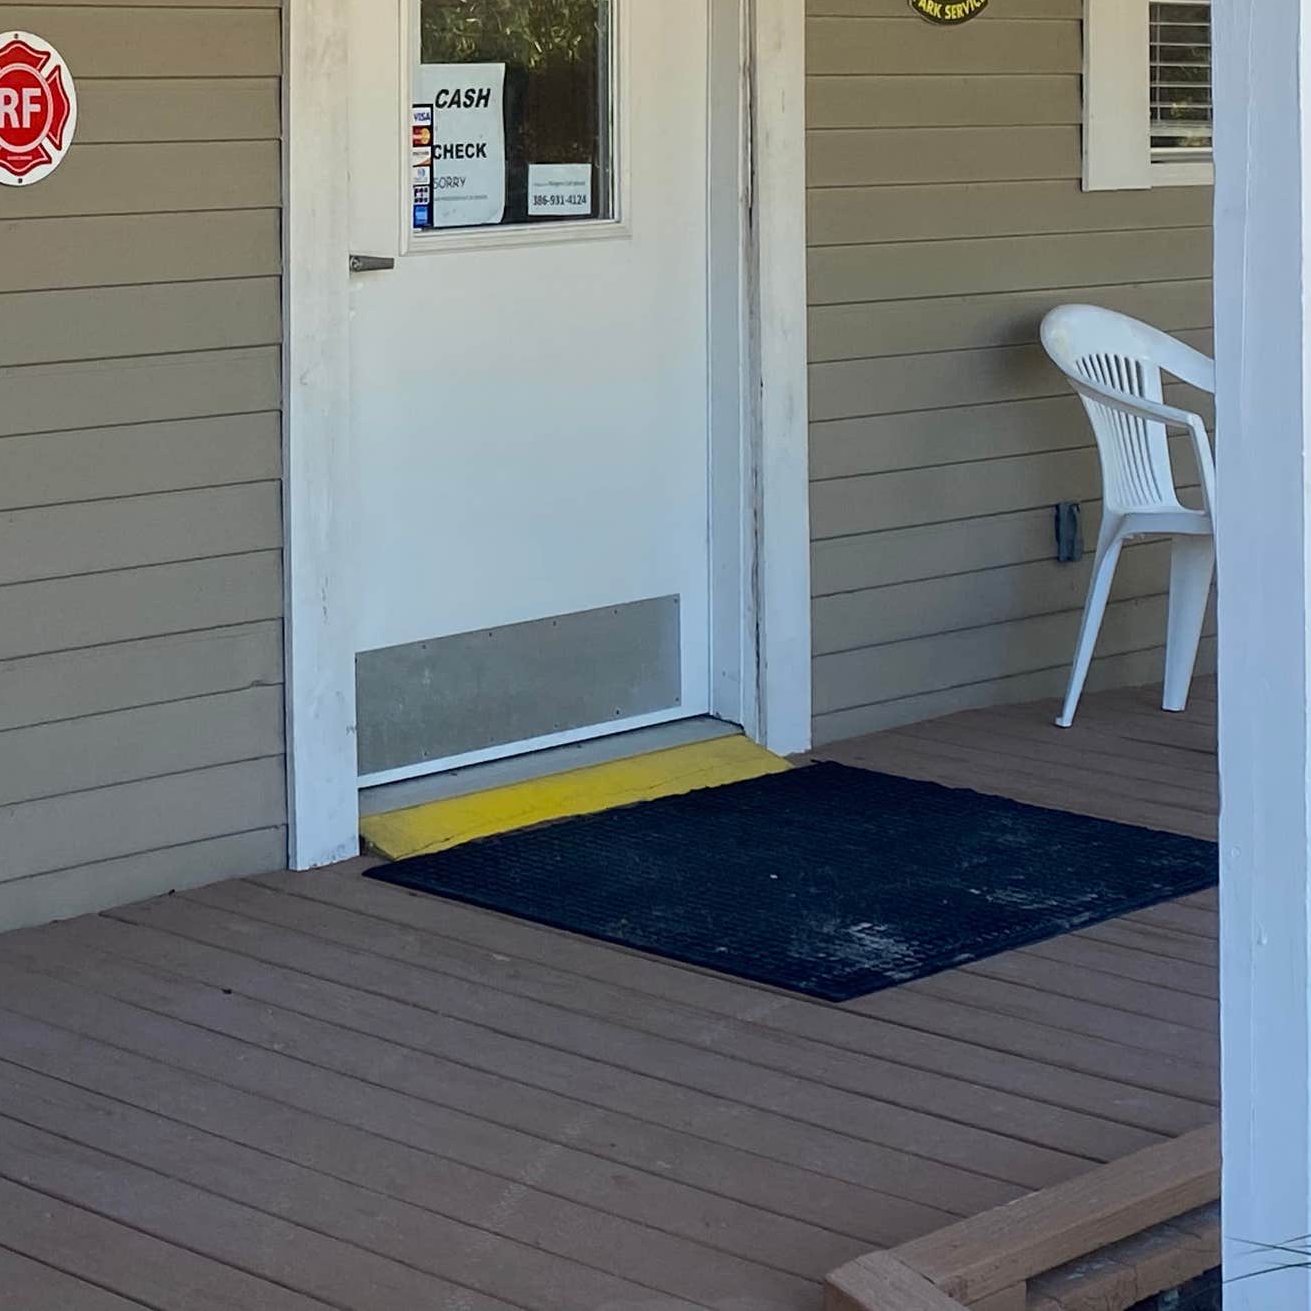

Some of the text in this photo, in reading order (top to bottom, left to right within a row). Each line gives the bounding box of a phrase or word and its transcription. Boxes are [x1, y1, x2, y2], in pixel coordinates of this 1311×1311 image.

[434, 88, 491, 109] CASH
[413, 112, 431, 121] VISA
[432, 142, 488, 160] CHECK
